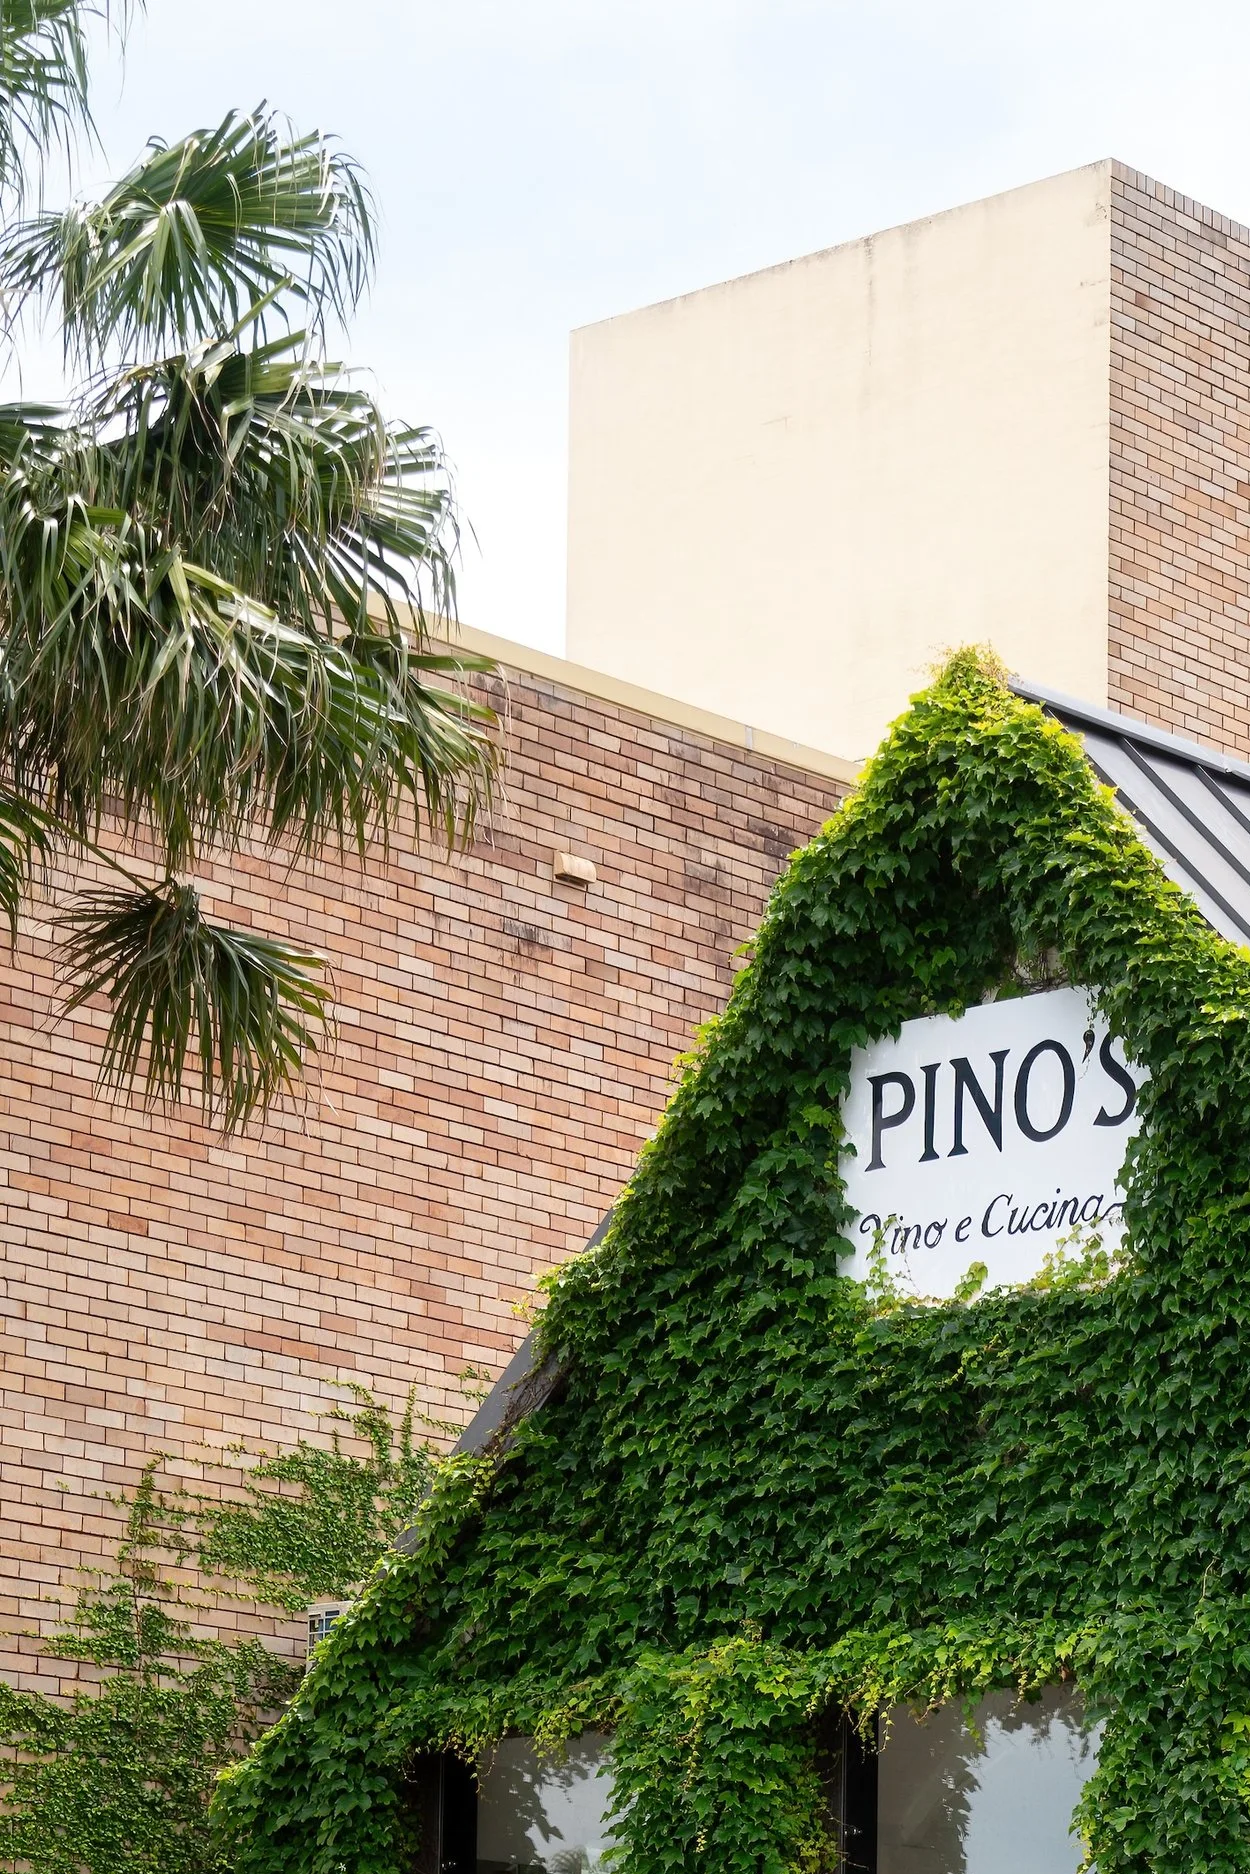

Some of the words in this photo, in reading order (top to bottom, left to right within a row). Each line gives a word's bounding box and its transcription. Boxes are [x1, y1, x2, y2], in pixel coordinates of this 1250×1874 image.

[864, 1030, 1137, 1172] PINO'S
[859, 1213, 947, 1255] Vino
[955, 1216, 972, 1242] e
[981, 1188, 1126, 1238] Cucina
